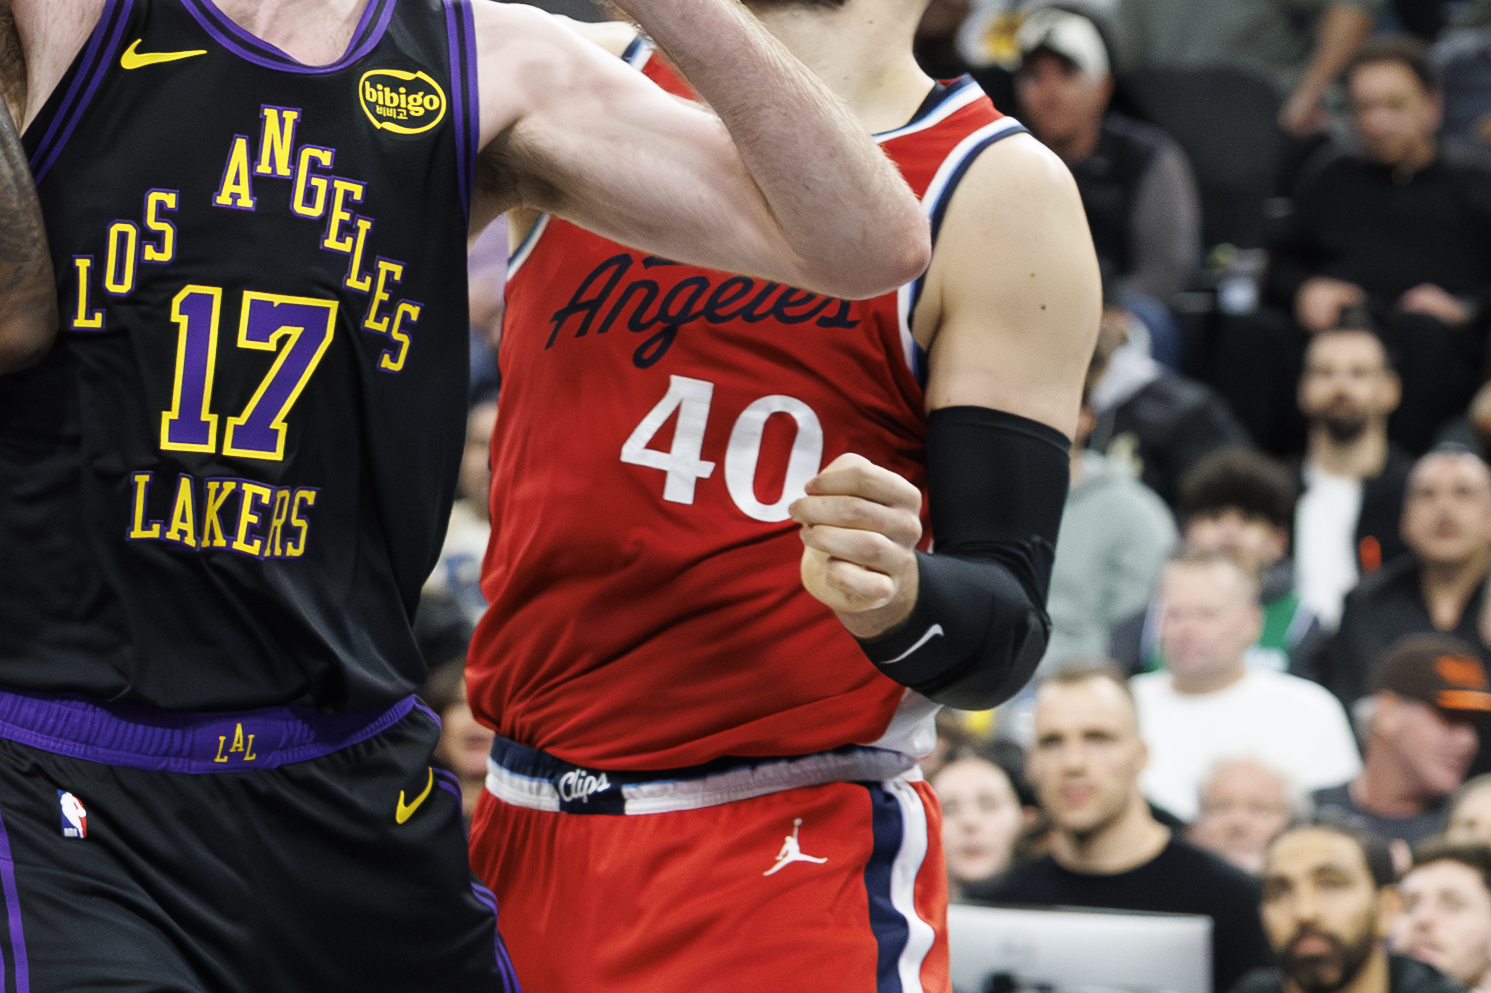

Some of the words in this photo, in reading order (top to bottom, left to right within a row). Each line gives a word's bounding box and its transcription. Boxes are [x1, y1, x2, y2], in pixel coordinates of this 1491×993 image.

[364, 80, 441, 117] bibigo
[71, 188, 178, 331] LOS
[212, 103, 425, 373] ANGELES
[159, 284, 339, 461] 17
[619, 374, 825, 523] 40
[126, 469, 322, 561] LAKERS
[213, 722, 257, 763] LAL
[558, 768, 612, 804] Clips
